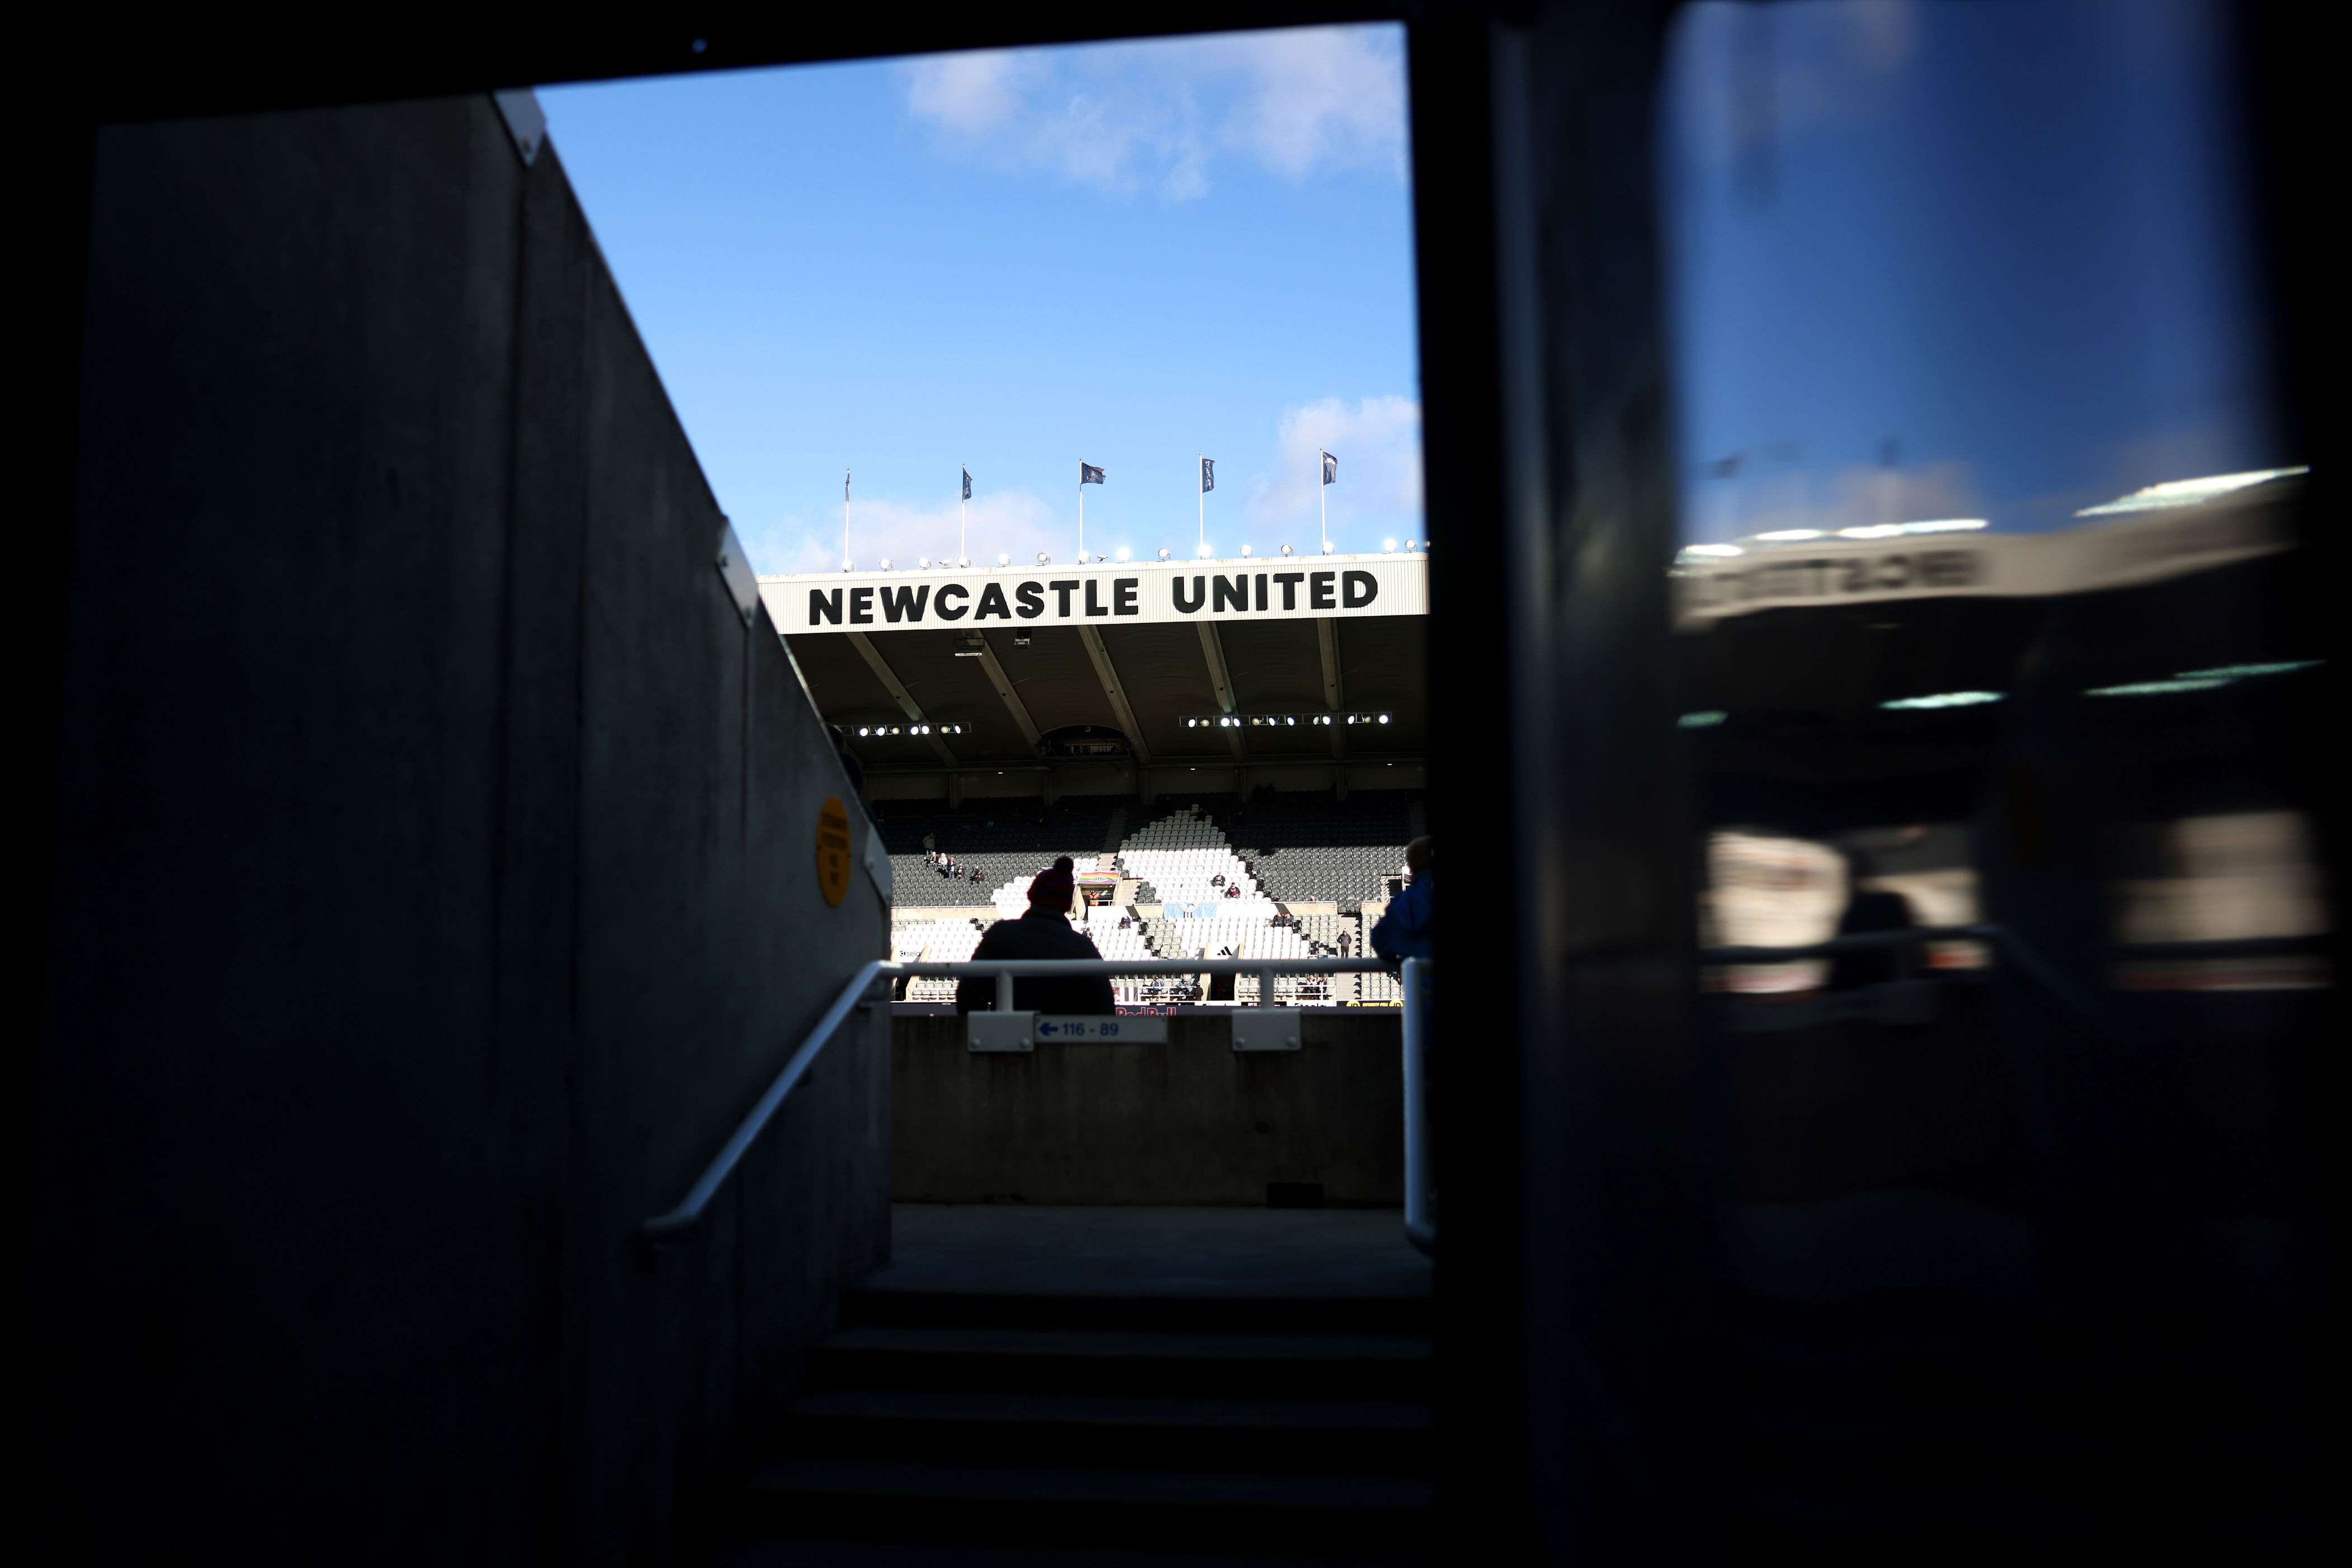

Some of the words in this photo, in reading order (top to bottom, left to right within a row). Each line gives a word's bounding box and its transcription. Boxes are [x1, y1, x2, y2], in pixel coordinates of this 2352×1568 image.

[809, 578, 1139, 626] NEWCASTLE
[1174, 571, 1378, 614] UNITED
[1147, 1007, 1176, 1016] Bll
[1063, 1023, 1085, 1035] 116
[1100, 1023, 1118, 1036] 89
